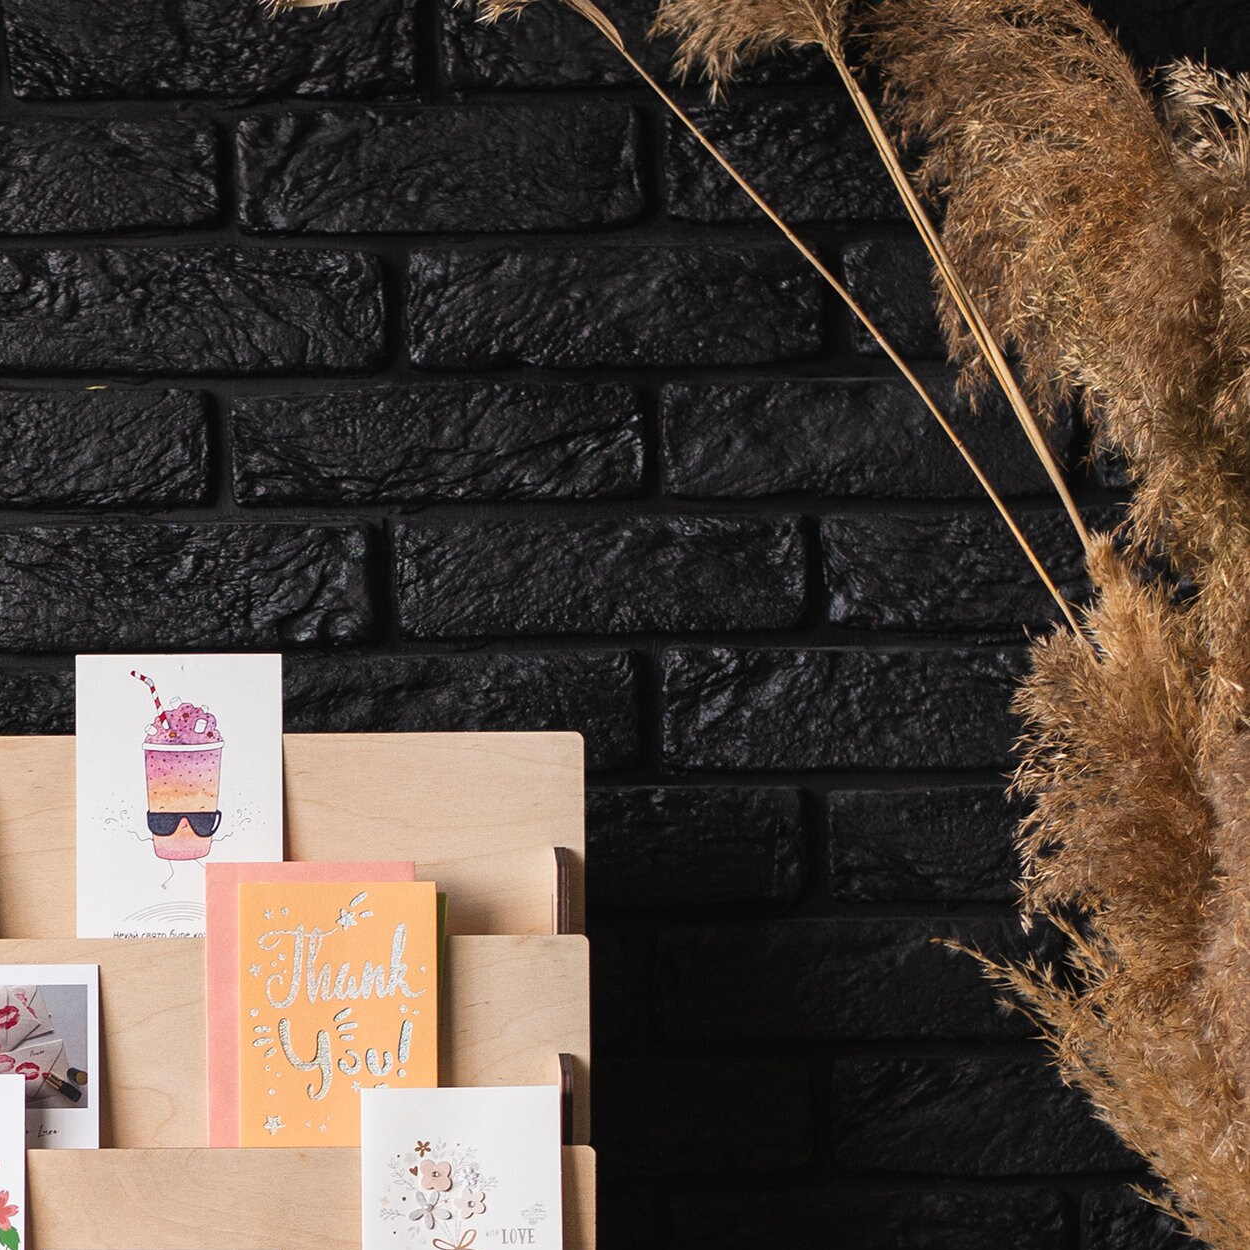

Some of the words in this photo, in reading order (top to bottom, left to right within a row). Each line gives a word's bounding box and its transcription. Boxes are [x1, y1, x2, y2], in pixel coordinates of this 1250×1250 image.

[257, 922, 427, 1009] Thank
[278, 1017, 414, 1101] You!
[501, 1228, 536, 1244] LOVE
